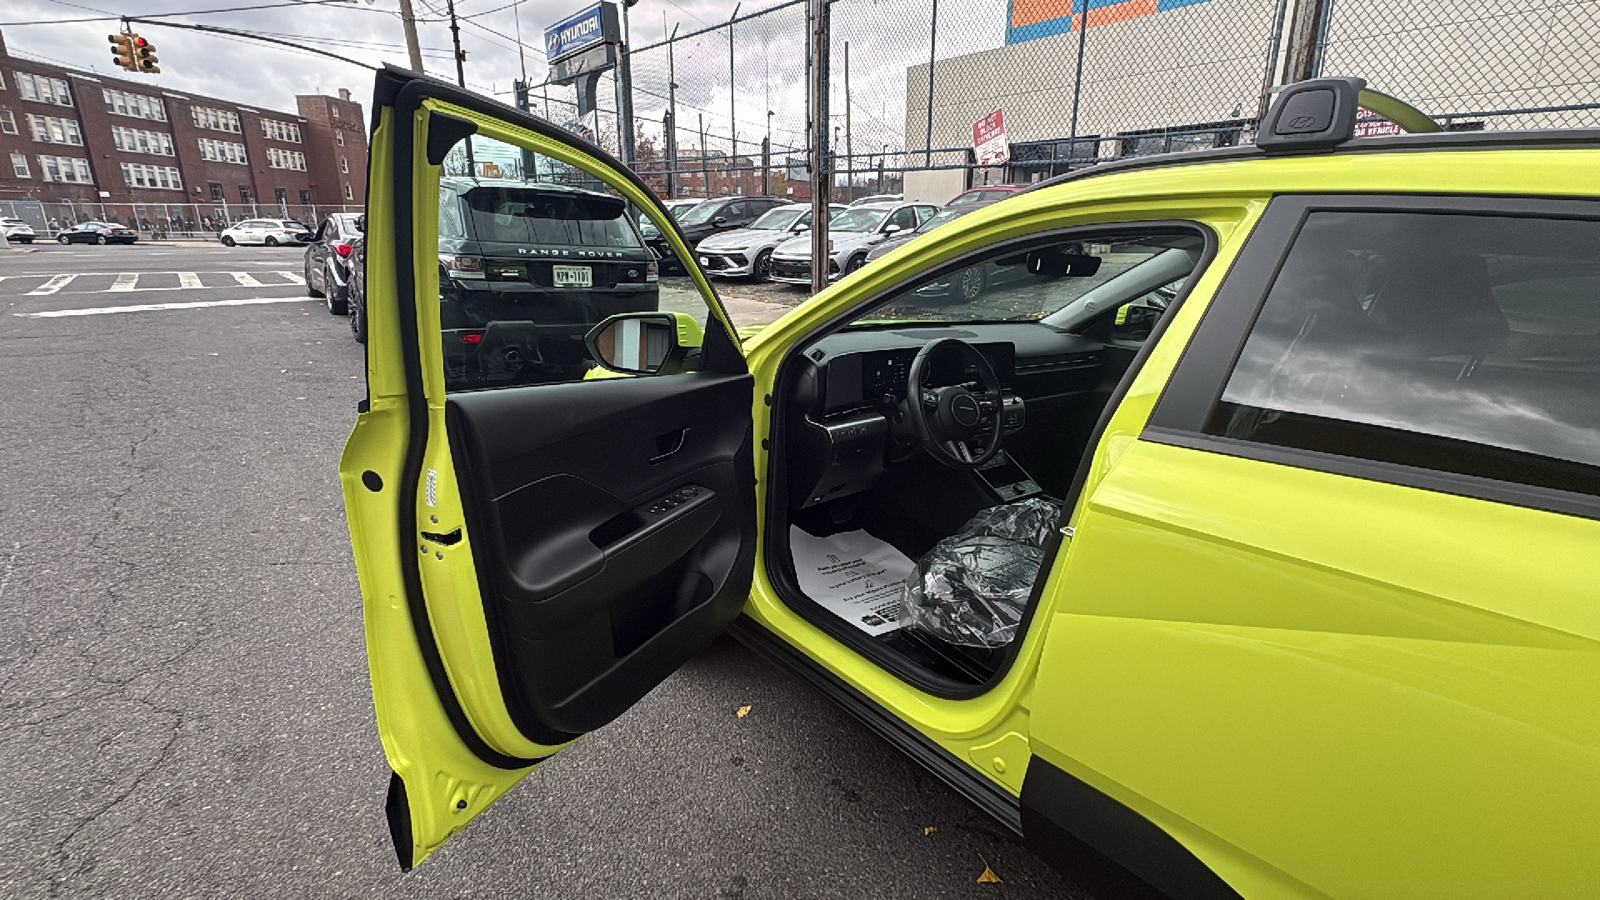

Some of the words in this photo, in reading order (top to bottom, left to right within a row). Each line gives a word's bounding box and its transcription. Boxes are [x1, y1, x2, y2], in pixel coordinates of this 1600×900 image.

[560, 15, 599, 45] HYUNDAI
[1368, 125, 1398, 135] VEHICLE
[518, 248, 569, 256] RANGE
